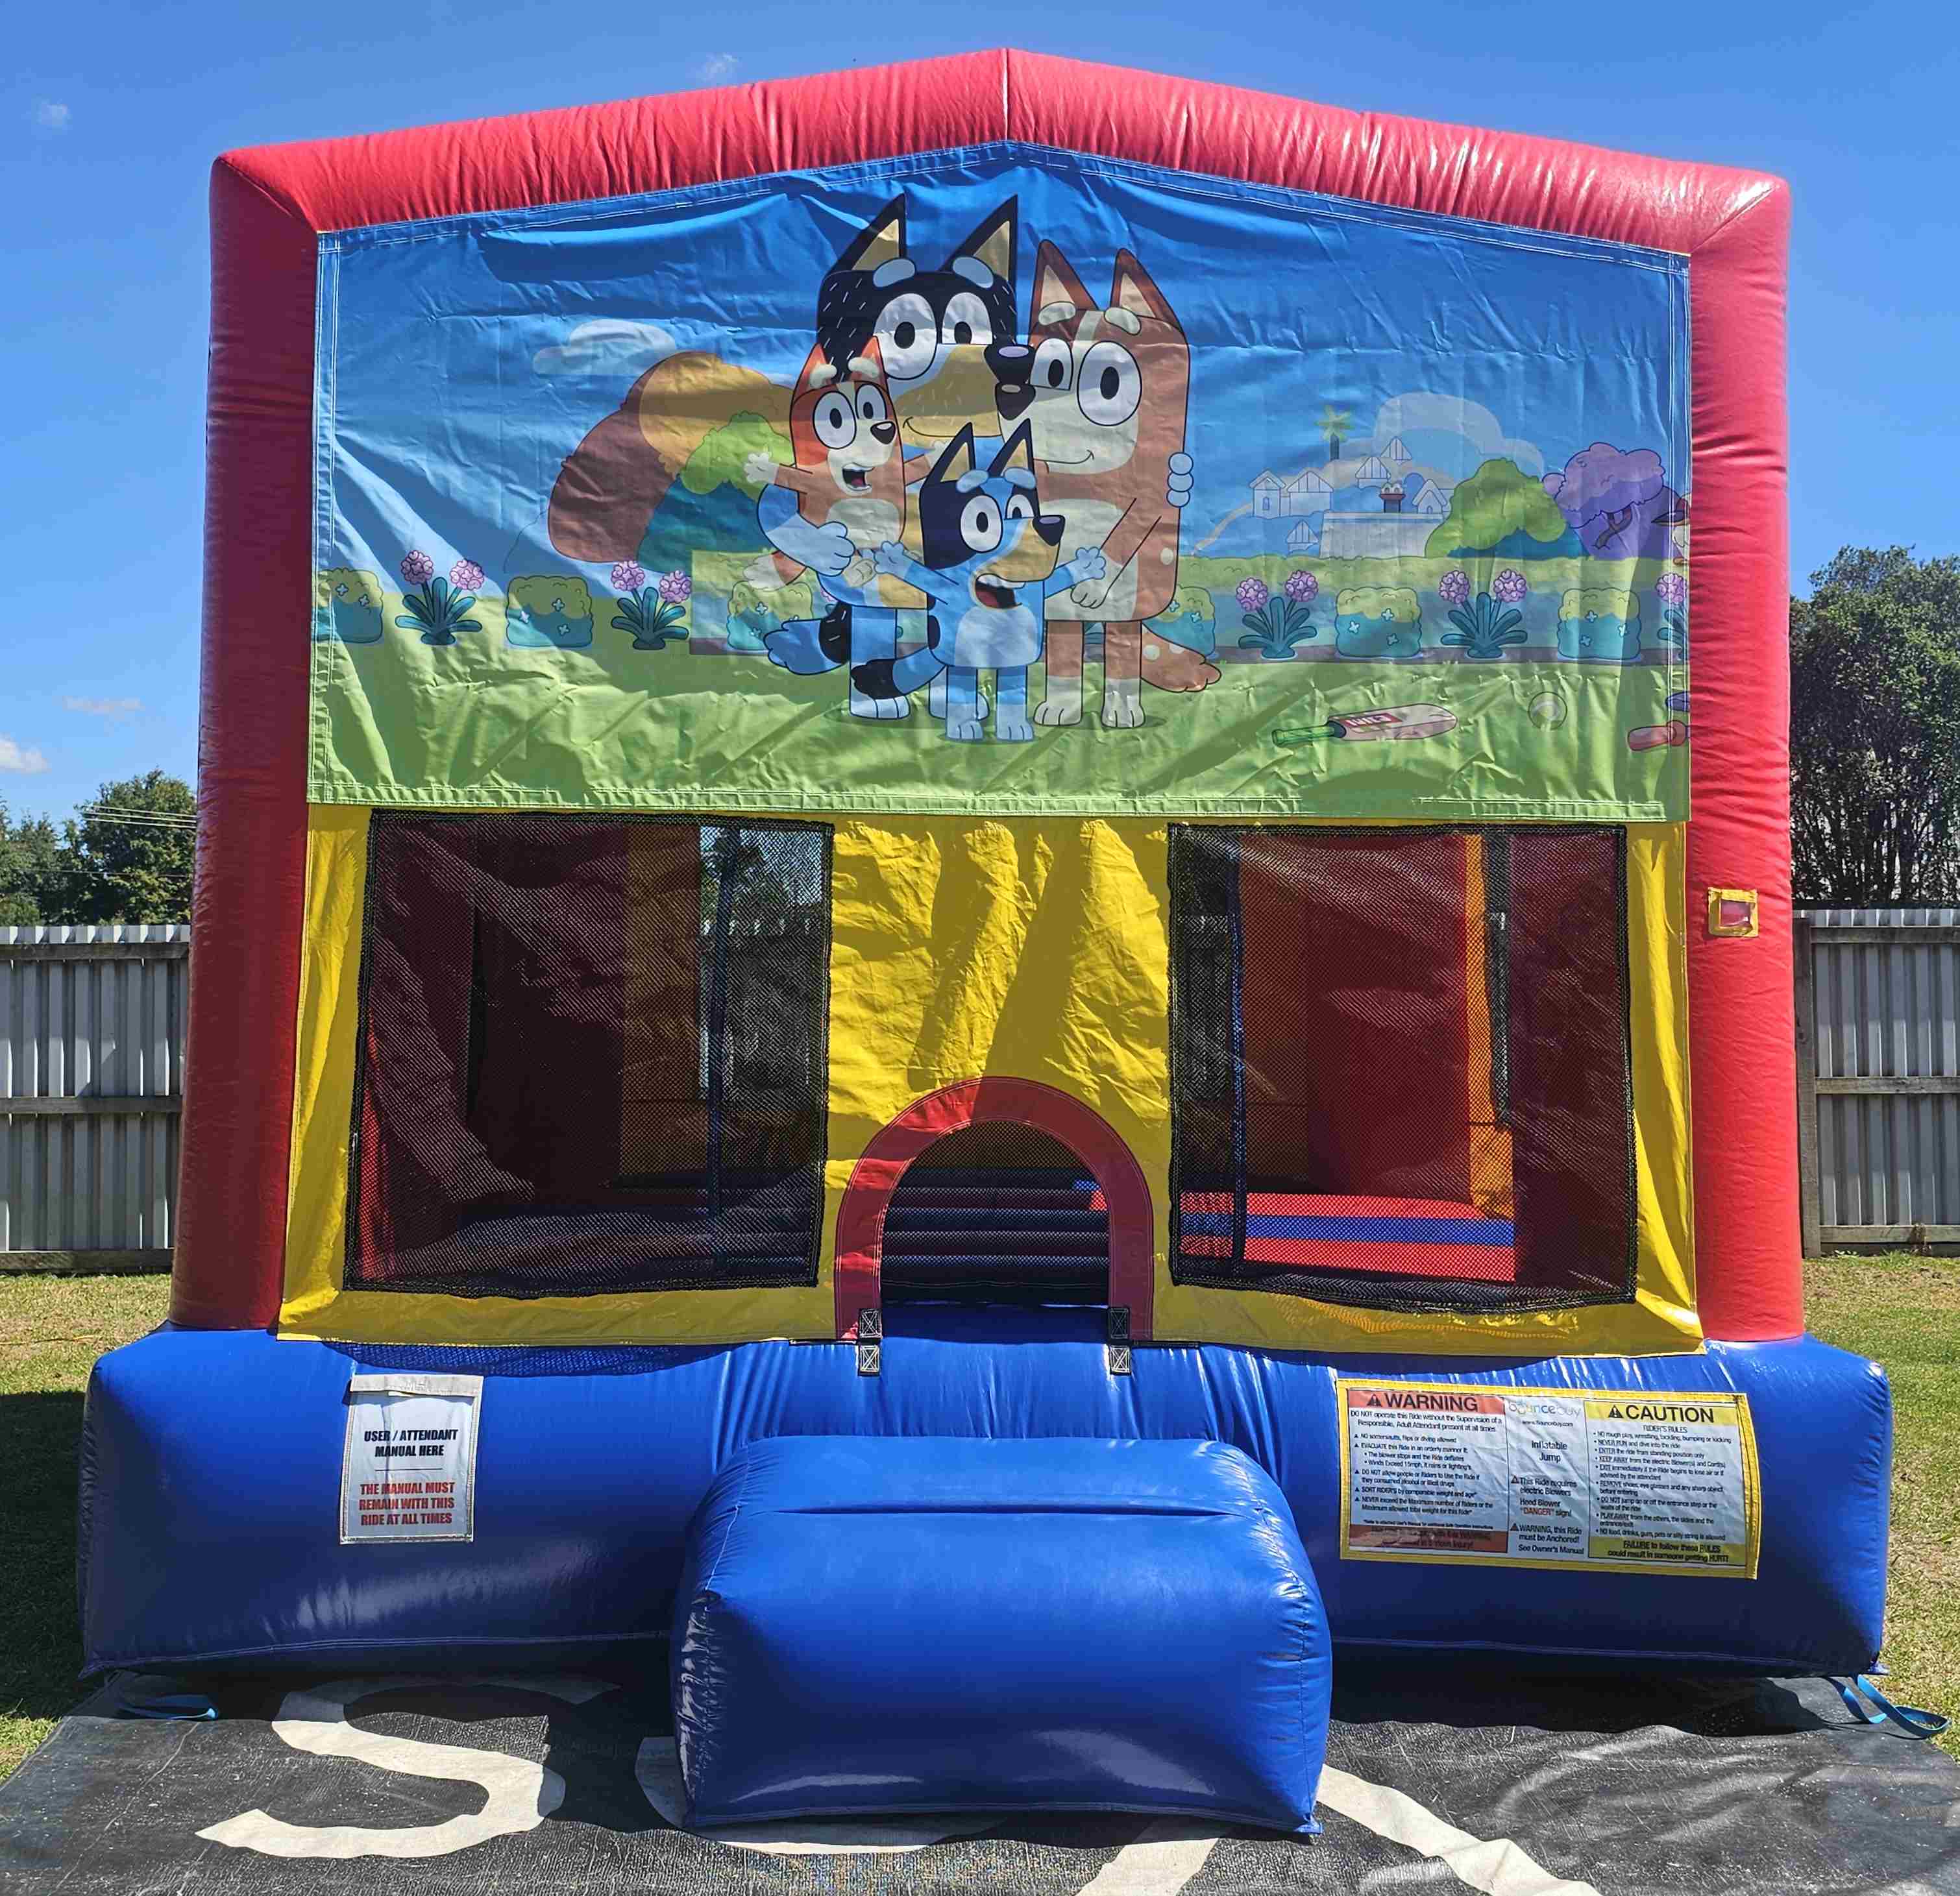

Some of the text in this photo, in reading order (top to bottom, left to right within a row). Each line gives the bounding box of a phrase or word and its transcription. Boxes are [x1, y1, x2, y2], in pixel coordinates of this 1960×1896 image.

[1384, 1394, 1478, 1411] WARNING
[1625, 1405, 1714, 1423] CAUTION
[364, 1431, 390, 1442] USER
[400, 1429, 458, 1441] ATTENDANT
[375, 1445, 444, 1457] MANUAL HERE
[1532, 1440, 1567, 1450] Inflatable
[1539, 1453, 1561, 1463] Jump
[360, 1482, 455, 1495] THE MANUAL MUST
[359, 1497, 454, 1511] REMAIN WITH THIS
[361, 1513, 452, 1525] RIDE AT ALL TIMES
